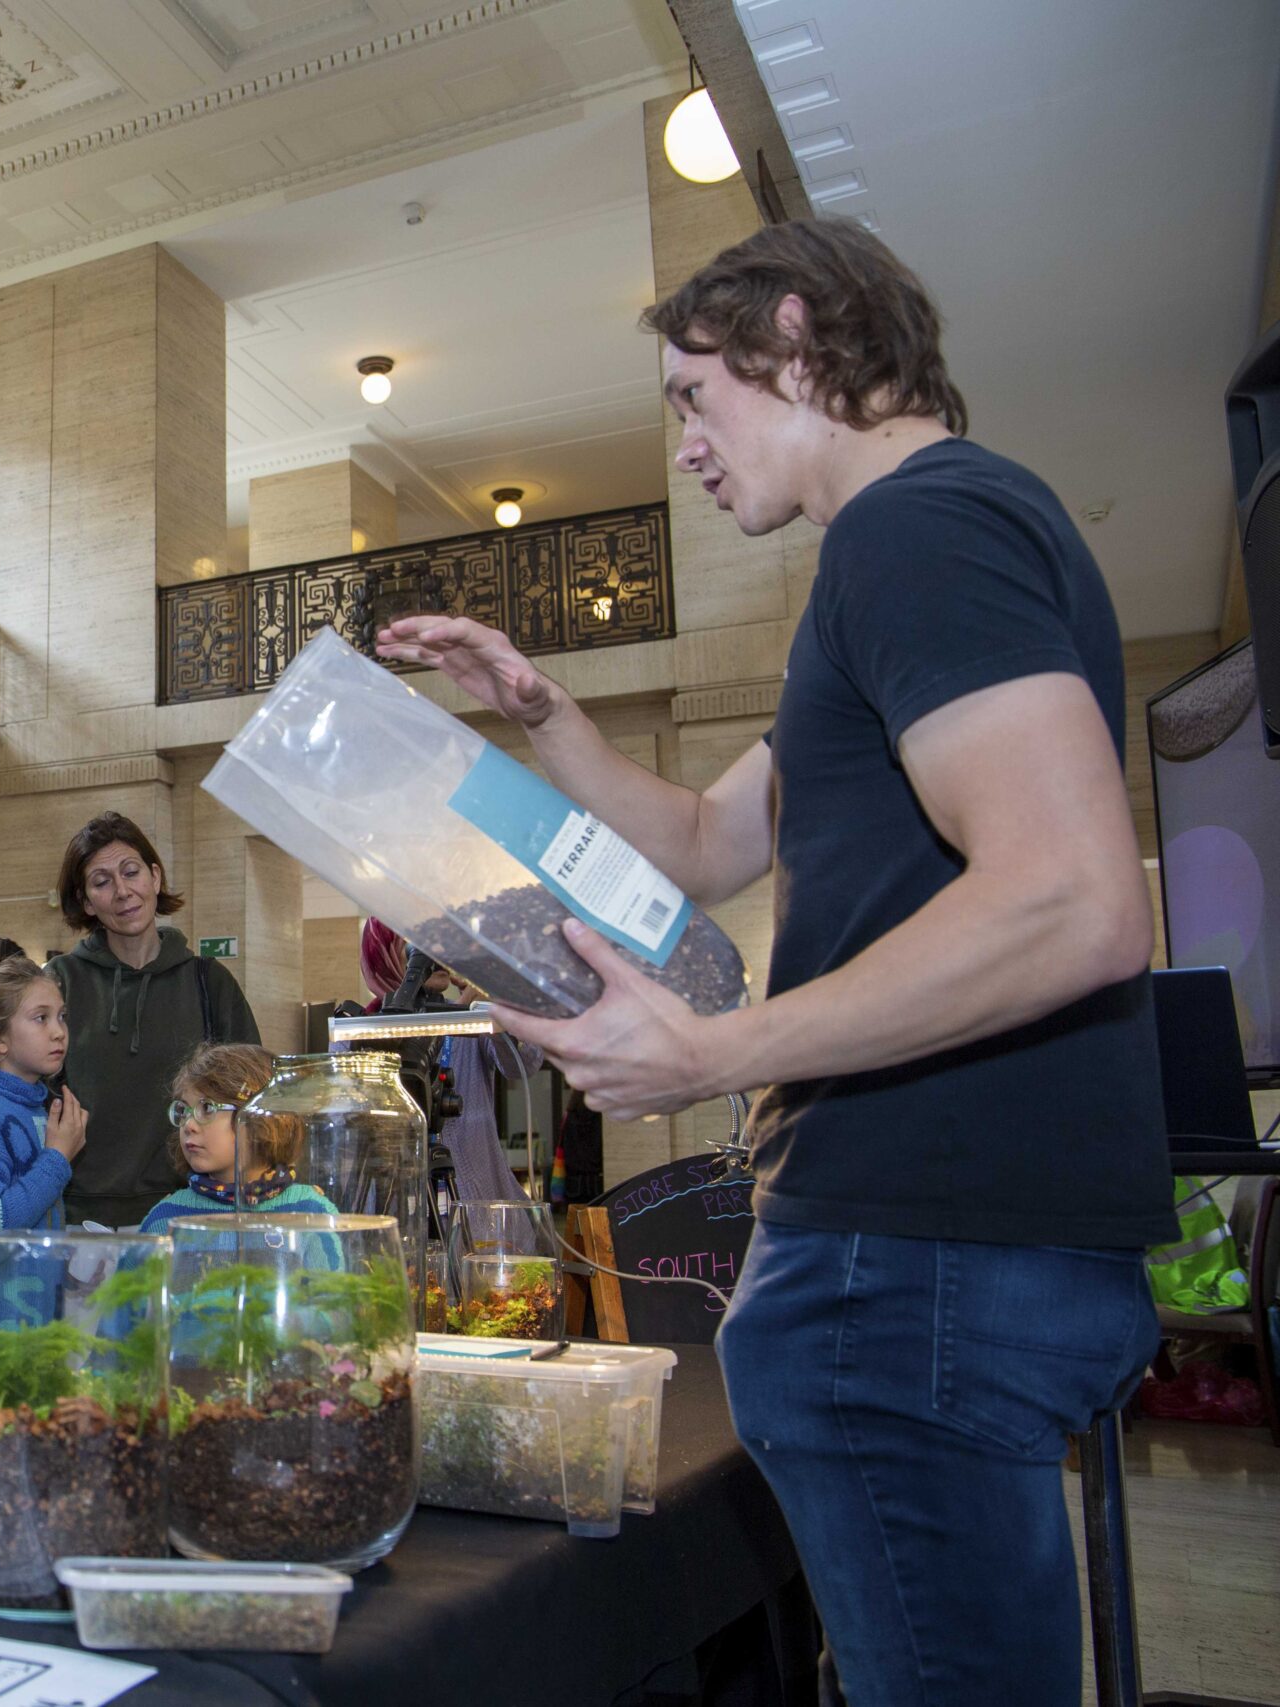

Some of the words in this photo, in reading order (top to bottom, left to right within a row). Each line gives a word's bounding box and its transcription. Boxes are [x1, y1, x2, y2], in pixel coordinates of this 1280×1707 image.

[614, 1173, 677, 1220] STORE
[702, 1188, 753, 1216] PAR
[637, 1252, 735, 1284] SOUTH
